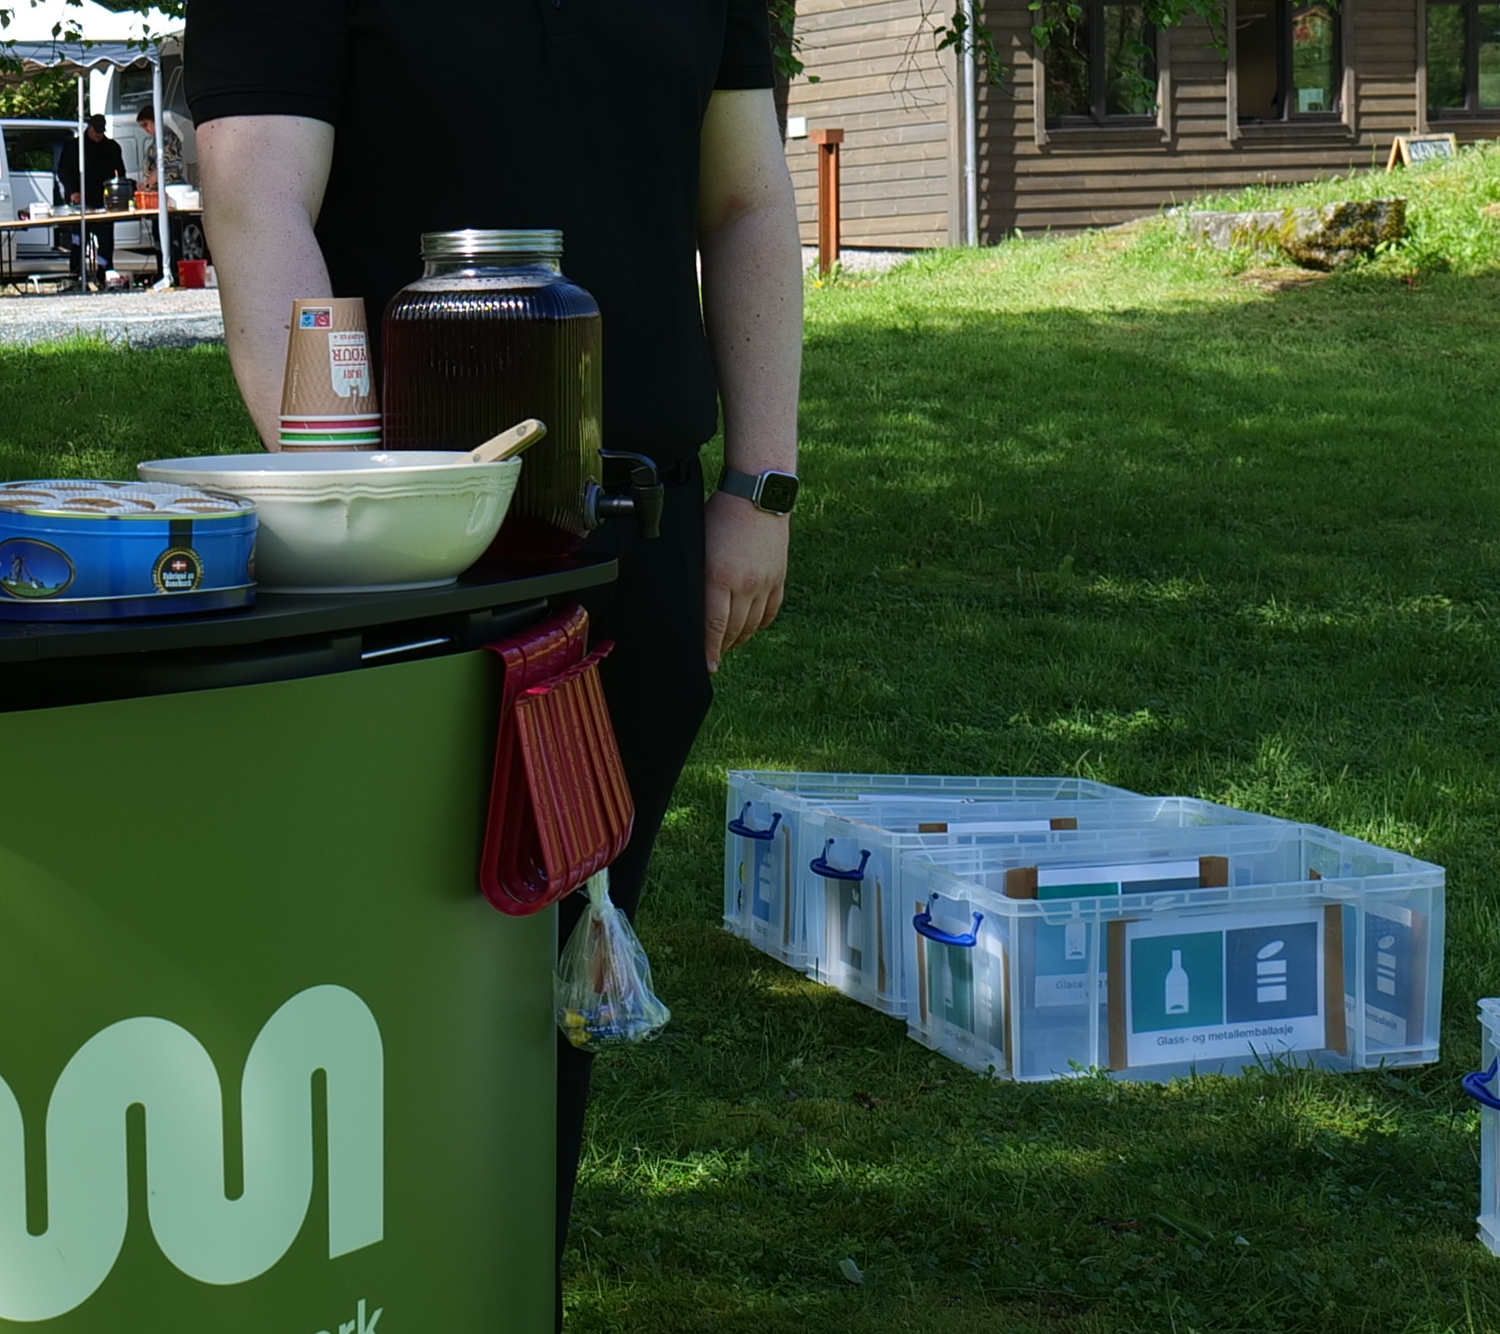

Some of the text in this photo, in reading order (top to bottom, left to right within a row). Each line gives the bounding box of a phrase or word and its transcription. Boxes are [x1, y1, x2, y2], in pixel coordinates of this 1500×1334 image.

[1157, 1025, 1294, 1046] Glass- og metallemballasje
